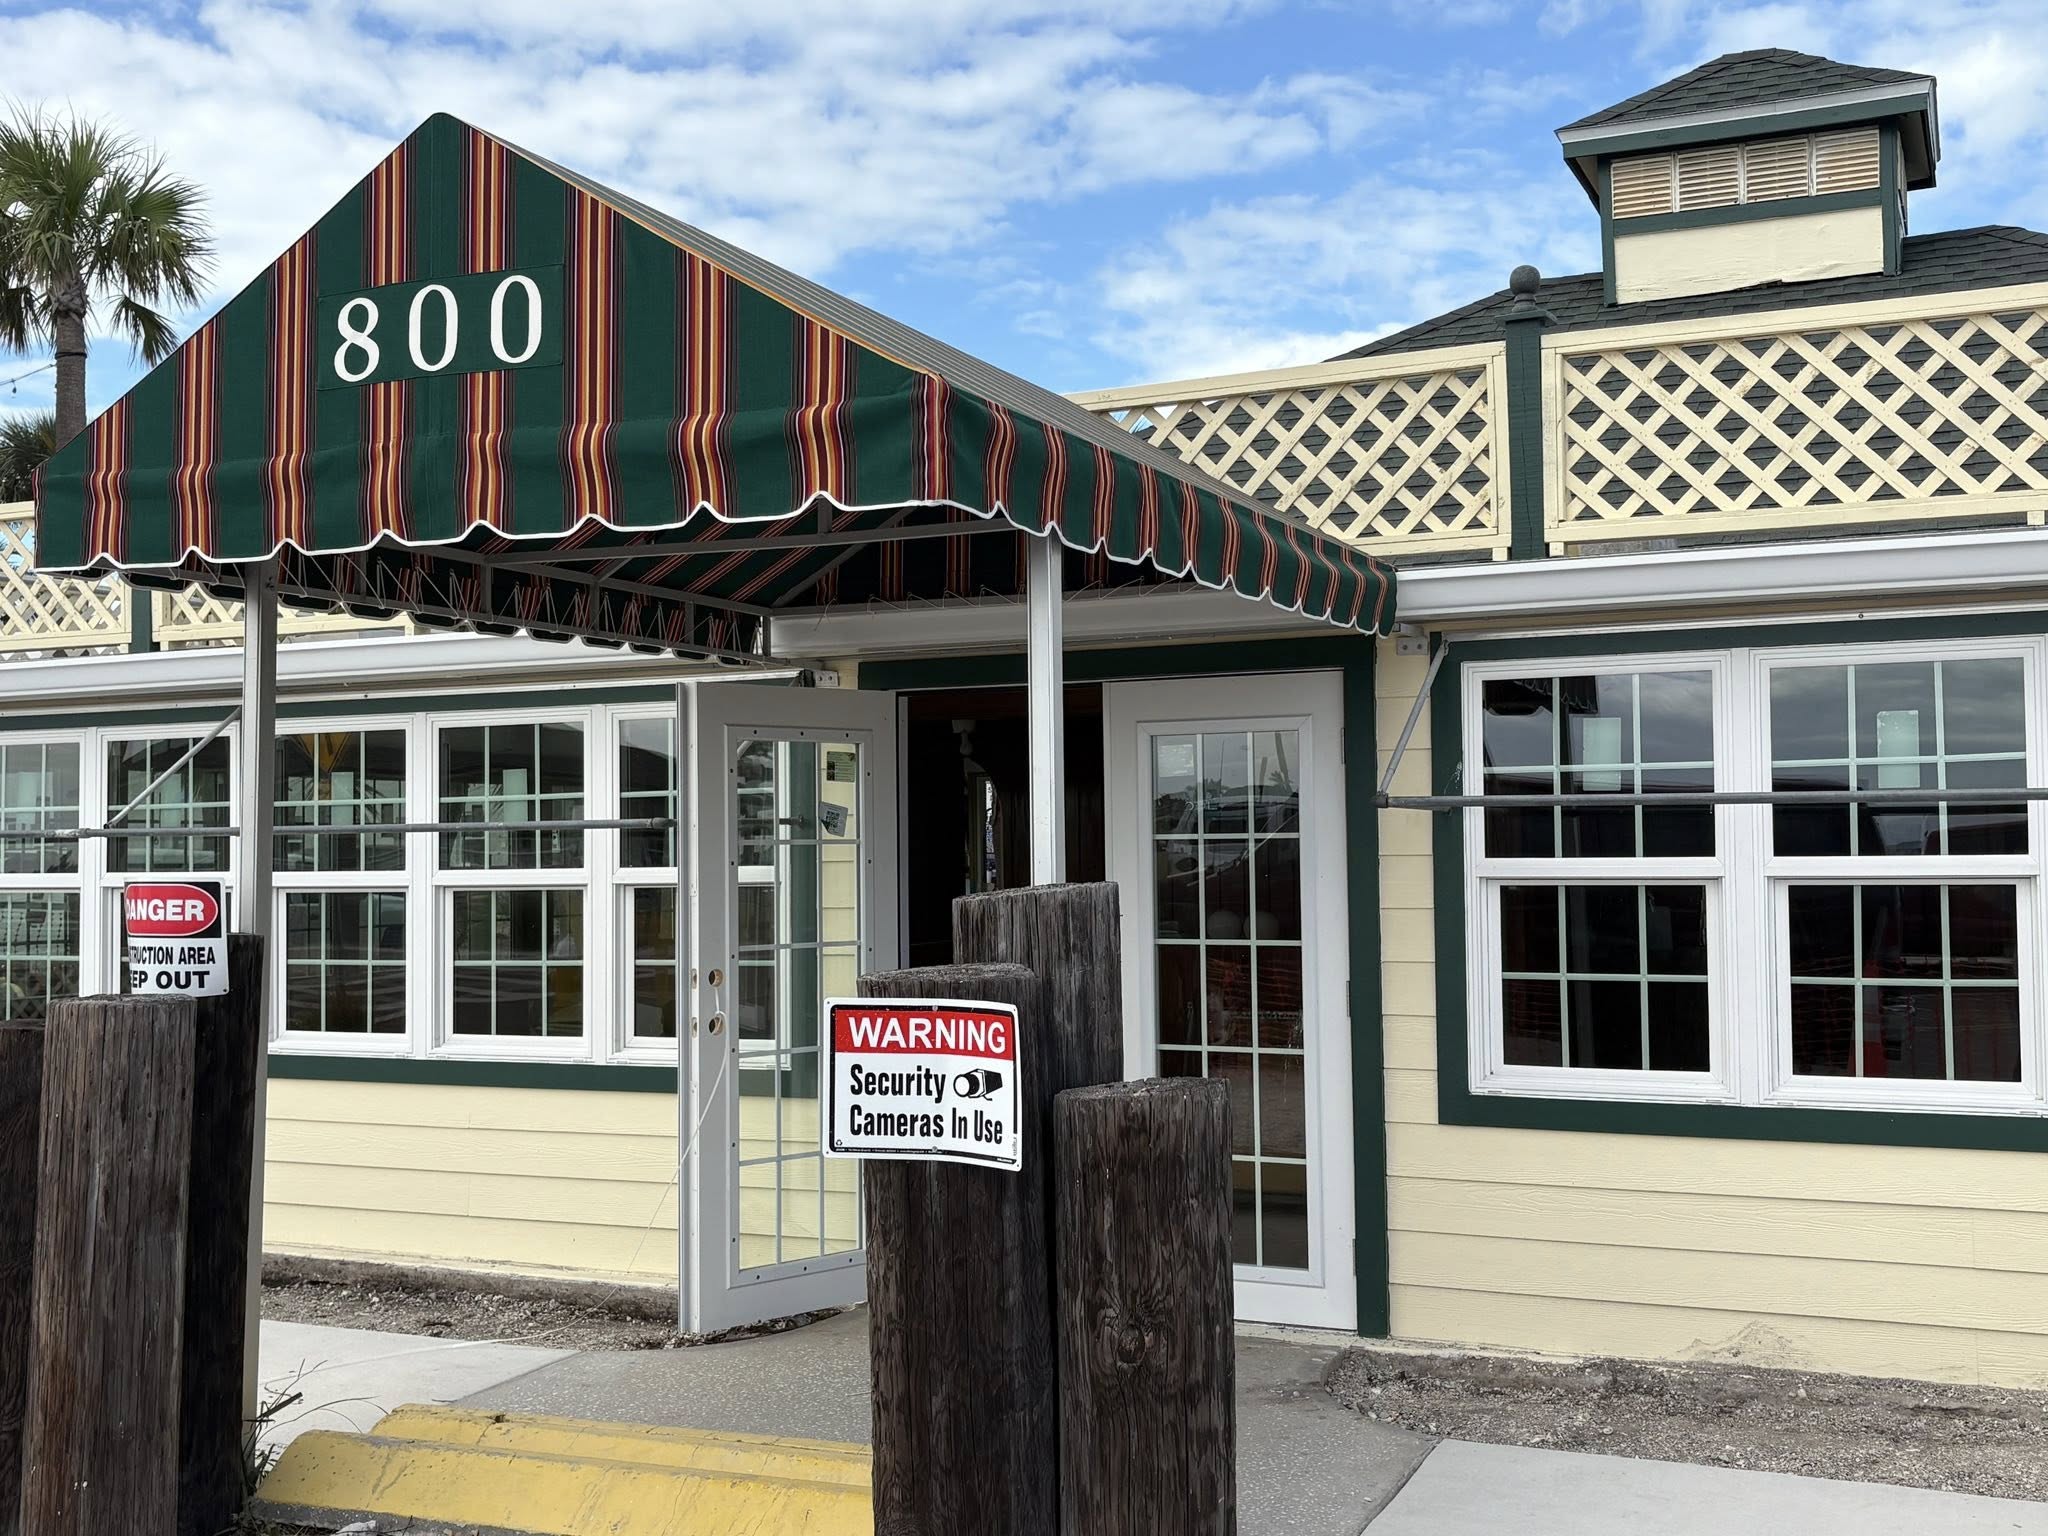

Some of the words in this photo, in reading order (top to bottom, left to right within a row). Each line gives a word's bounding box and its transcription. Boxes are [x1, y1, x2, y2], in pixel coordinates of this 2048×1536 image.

[334, 274, 542, 383] 800
[178, 946, 216, 965] AREA
[156, 970, 210, 990] OUT
[849, 1016, 1006, 1054] WARNING
[850, 1063, 946, 1104] Security
[850, 1104, 944, 1138] Cameras
[952, 1107, 968, 1140] In
[974, 1109, 1003, 1145] Use
